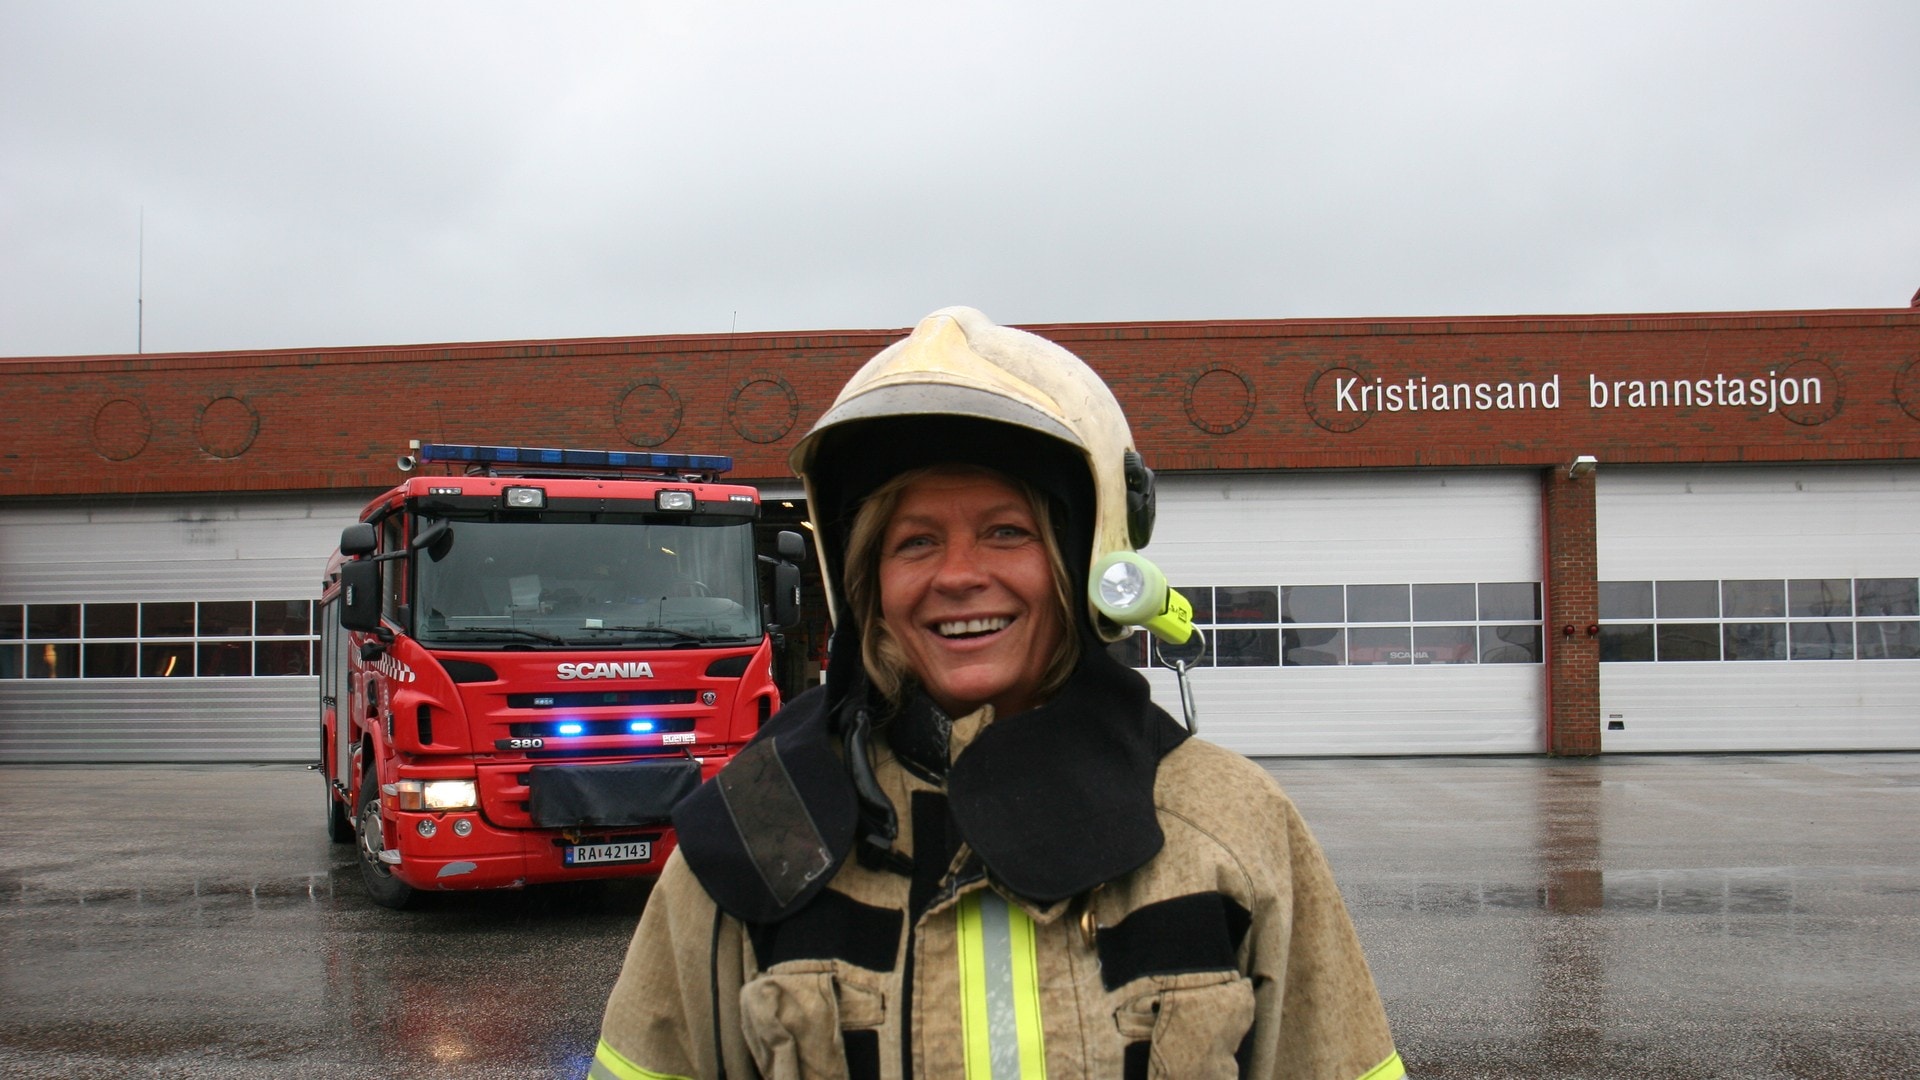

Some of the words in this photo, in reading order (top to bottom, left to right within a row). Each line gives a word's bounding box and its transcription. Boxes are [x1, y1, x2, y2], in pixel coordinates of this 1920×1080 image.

[1335, 375, 1560, 412] Kristiansand
[1589, 371, 1822, 413] brannstasjon
[557, 662, 654, 680] SCANIA
[510, 739, 543, 749] 380
[578, 847, 597, 861] RA
[604, 844, 647, 859] 42143
